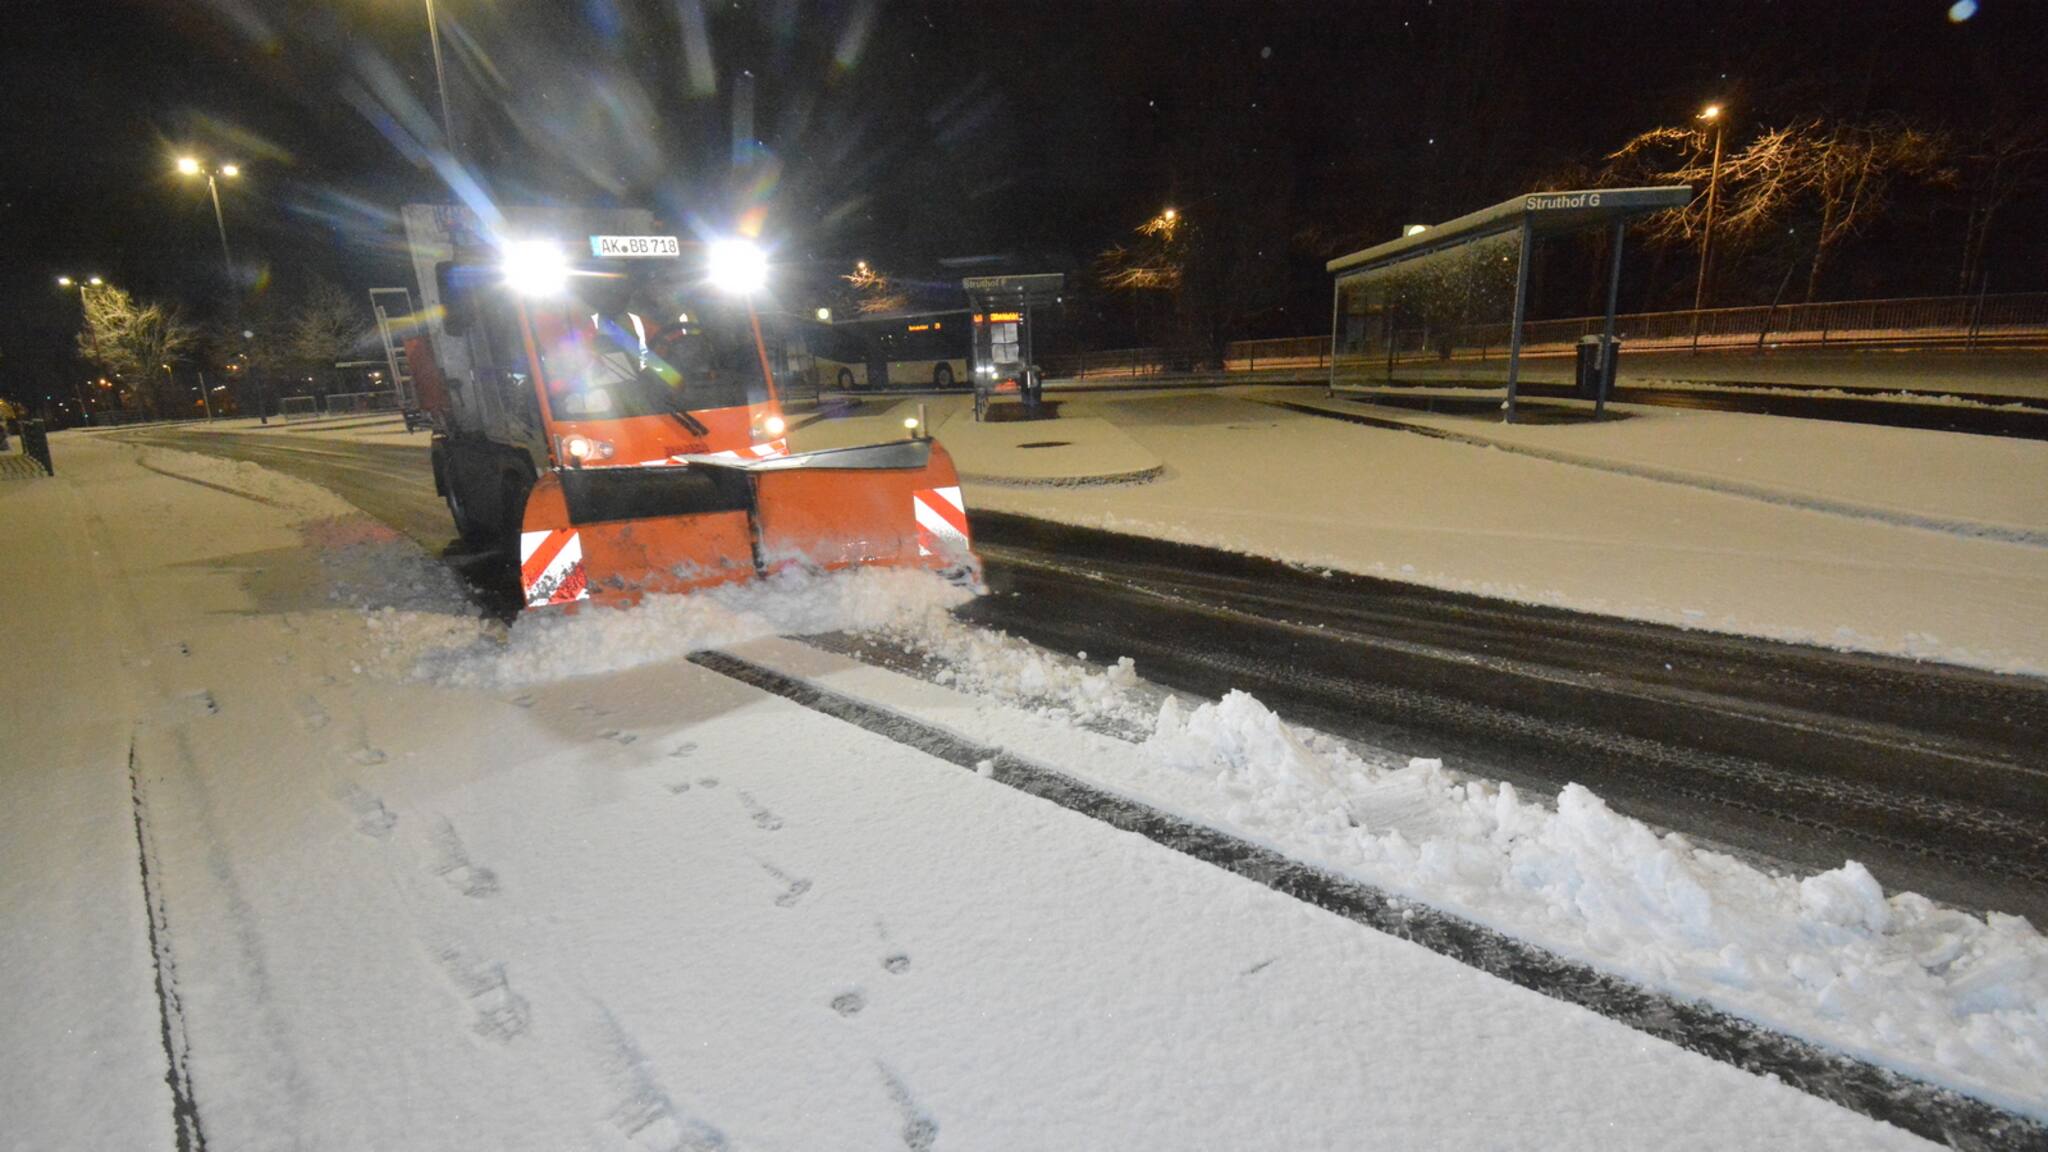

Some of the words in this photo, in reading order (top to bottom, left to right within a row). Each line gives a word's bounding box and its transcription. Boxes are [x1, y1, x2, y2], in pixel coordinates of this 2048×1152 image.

[1526, 194, 1586, 210] Struthof
[1588, 193, 1600, 207] G
[963, 278, 999, 289] Struthof
